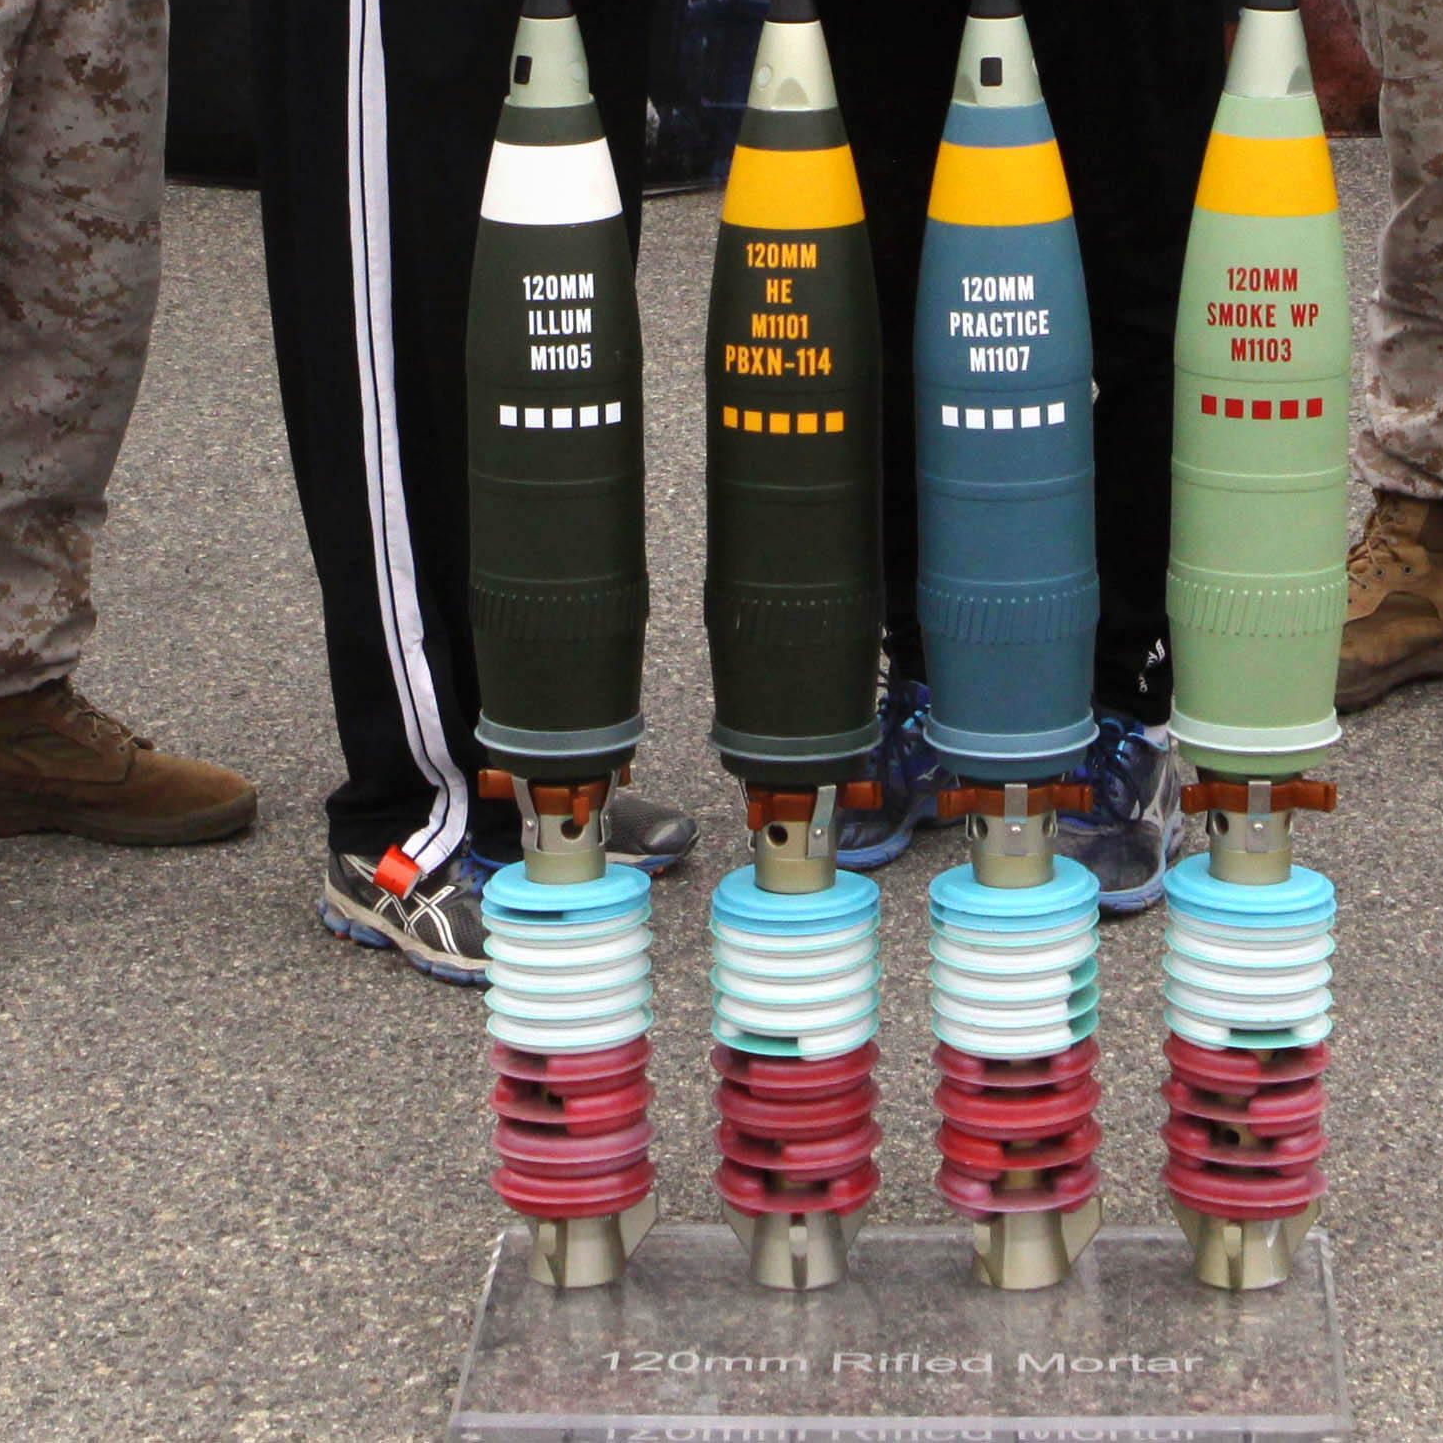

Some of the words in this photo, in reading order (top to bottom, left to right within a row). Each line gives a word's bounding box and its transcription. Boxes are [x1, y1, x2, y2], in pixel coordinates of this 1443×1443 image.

[745, 242, 818, 270] 120MM
[522, 273, 595, 301] 120MM
[765, 277, 794, 305] HE
[961, 275, 1035, 303] 120MM
[1226, 267, 1299, 293] 120MM
[527, 308, 592, 336] ILLUM
[750, 313, 809, 341] M1101
[949, 309, 1050, 339] PRACTICE
[1206, 302, 1277, 329] SMOKE
[1290, 303, 1320, 329] WP
[530, 343, 592, 372] M1105
[724, 343, 833, 378] PBXN-114
[968, 345, 1030, 373] M1107
[1230, 337, 1293, 364] M1103
[600, 1349, 808, 1374] 120mm
[831, 1351, 993, 1374] Rifled
[1016, 1351, 1206, 1374] Mortar
